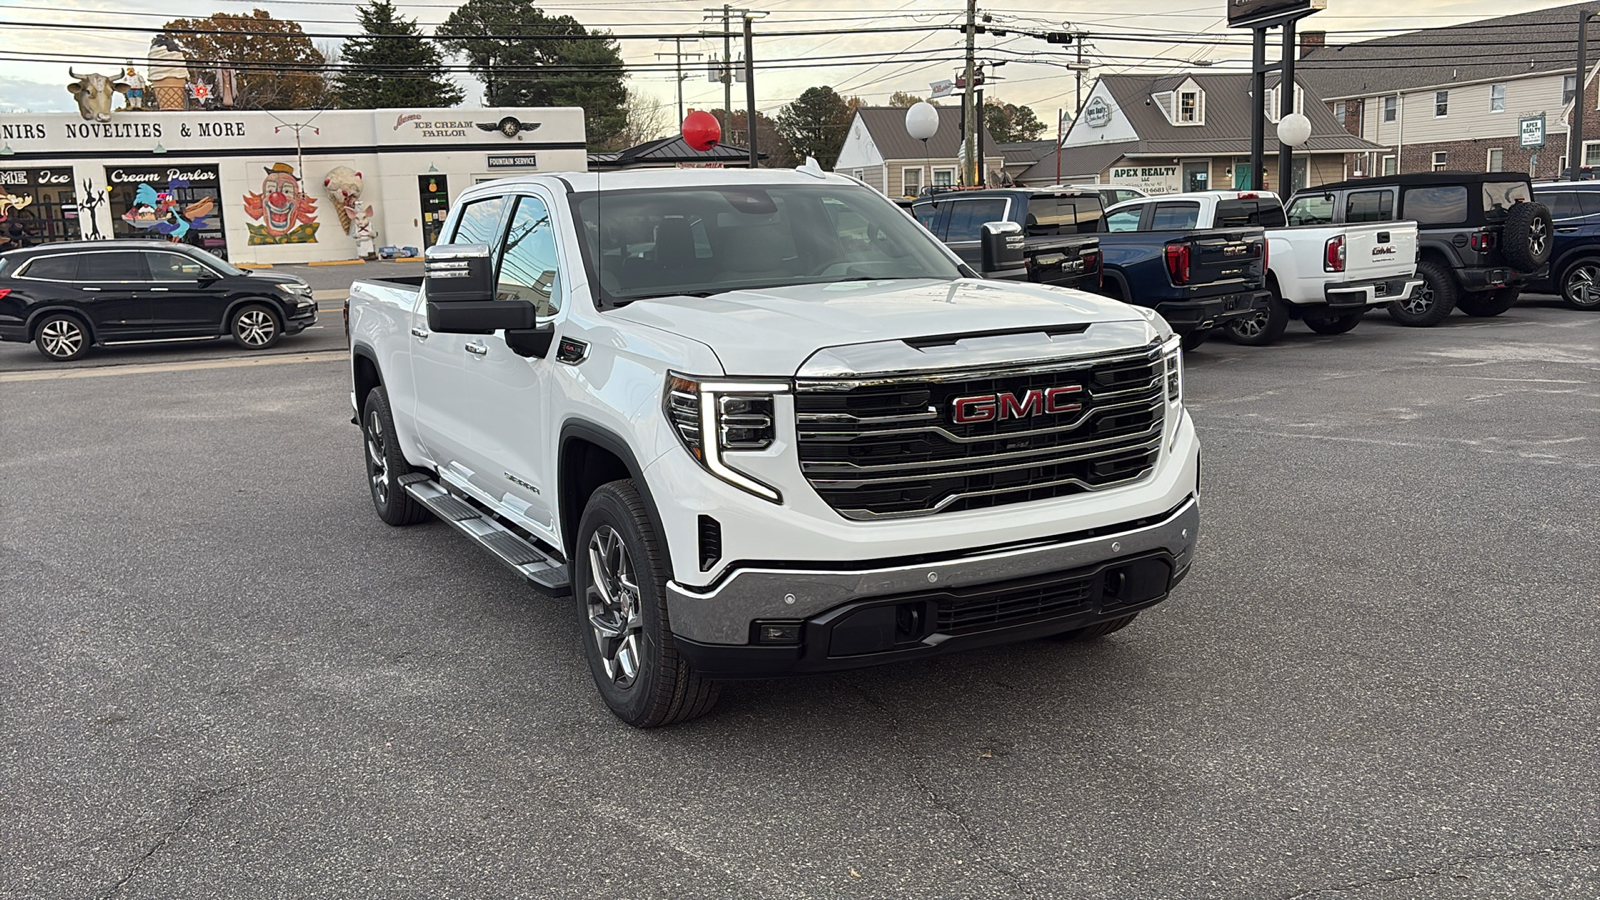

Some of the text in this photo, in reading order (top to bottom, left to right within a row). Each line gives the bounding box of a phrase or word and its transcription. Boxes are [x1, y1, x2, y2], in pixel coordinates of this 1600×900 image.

[0, 122, 246, 139] NIRS NOVELTIES & MORE
[414, 121, 433, 129] ICE
[434, 121, 474, 129] CREAM
[422, 129, 467, 138] PARLOR
[489, 157, 535, 166] FOUNTAIN SERVICE
[38, 170, 71, 184] Ice
[110, 168, 217, 183] Cream Parlor
[1114, 167, 1177, 178] APEX REALTY
[1371, 245, 1397, 256] GMC
[952, 385, 1082, 424] GMC
